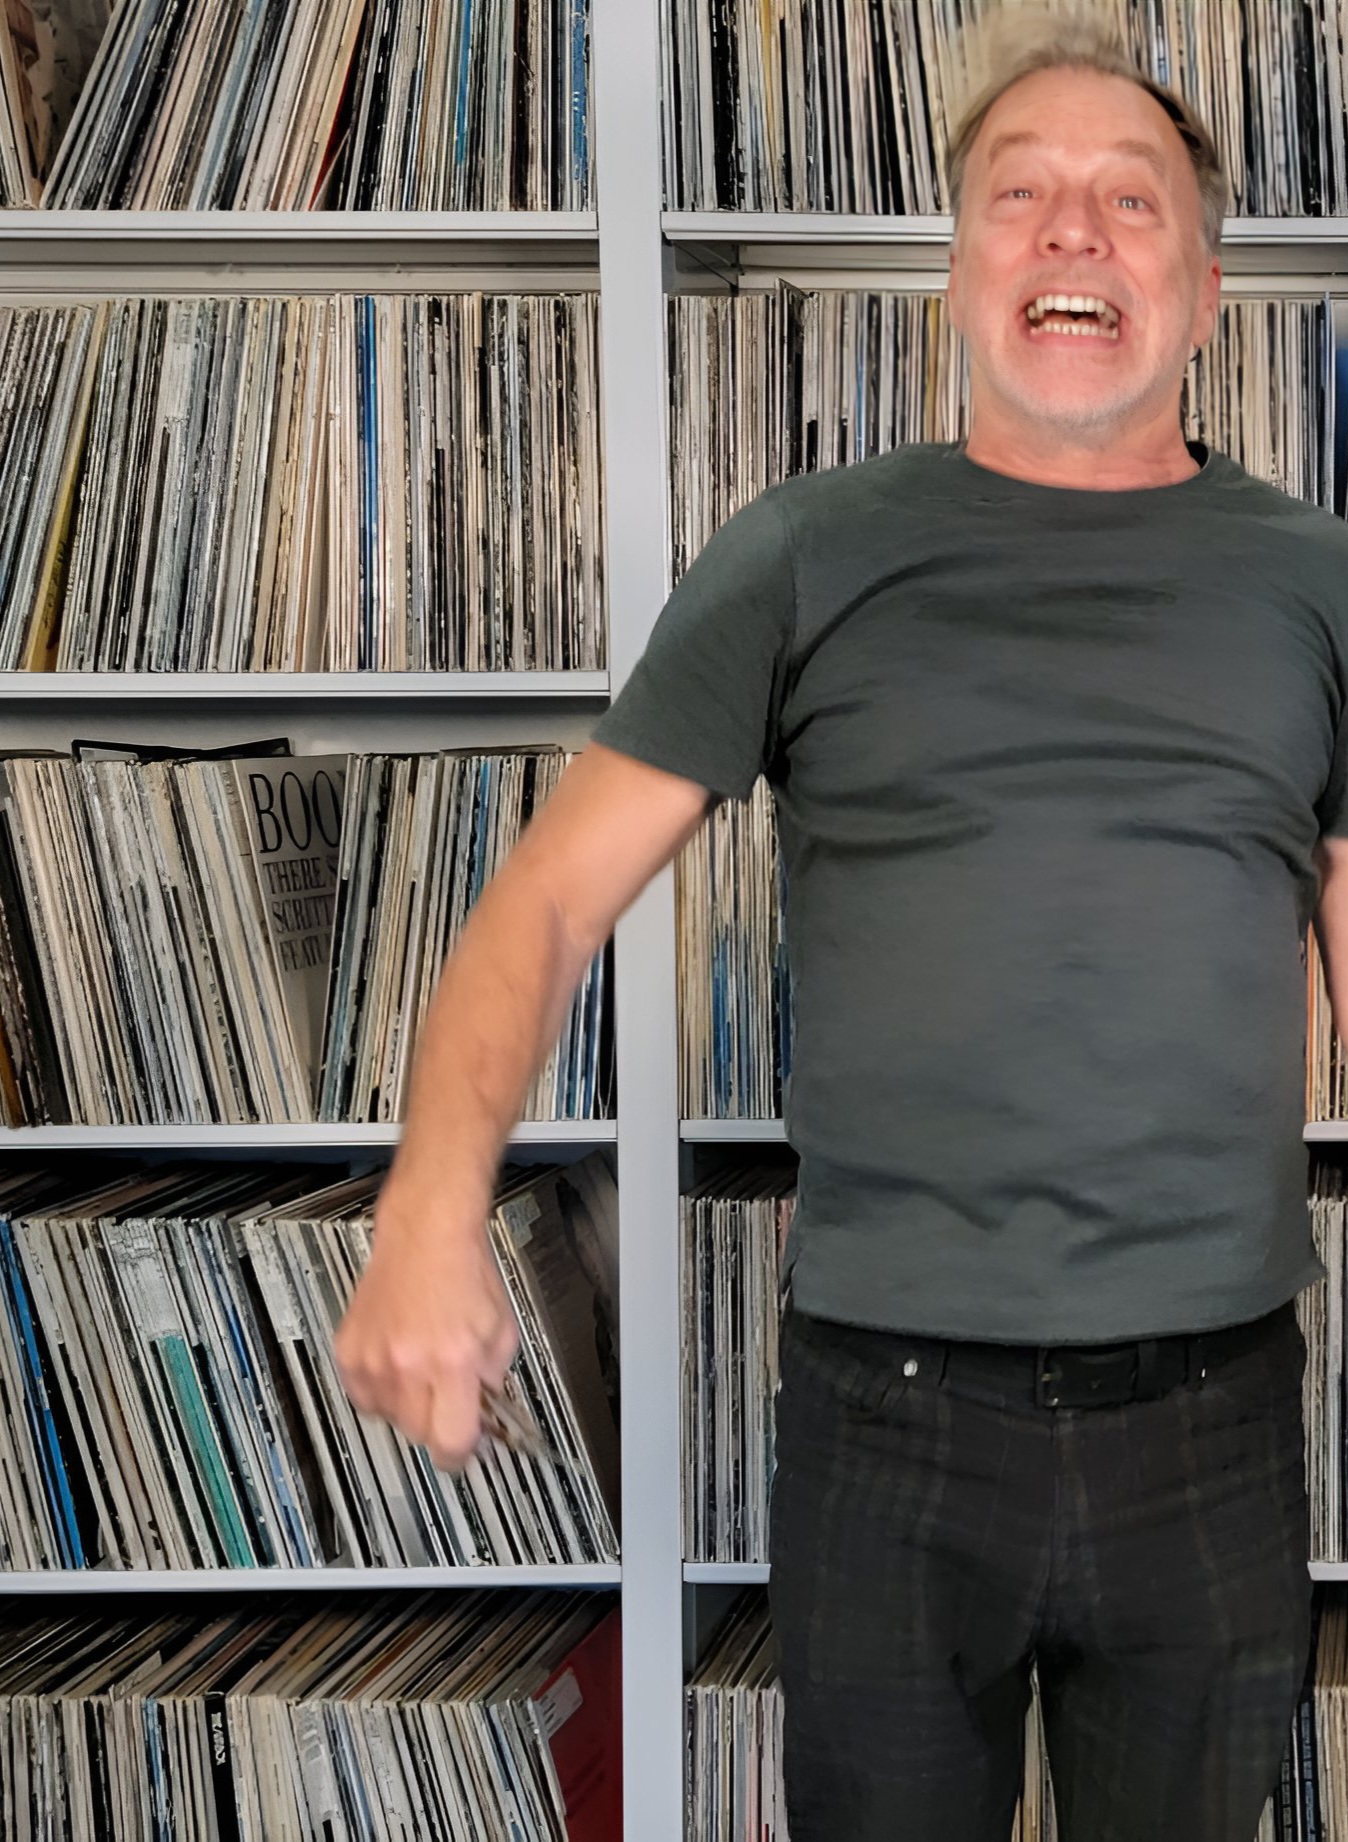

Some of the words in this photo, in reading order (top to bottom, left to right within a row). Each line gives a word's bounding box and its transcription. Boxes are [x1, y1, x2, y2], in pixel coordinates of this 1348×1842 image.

[248, 769, 346, 854] BOO
[262, 857, 327, 895] THERE
[271, 893, 336, 934] SCRITT
